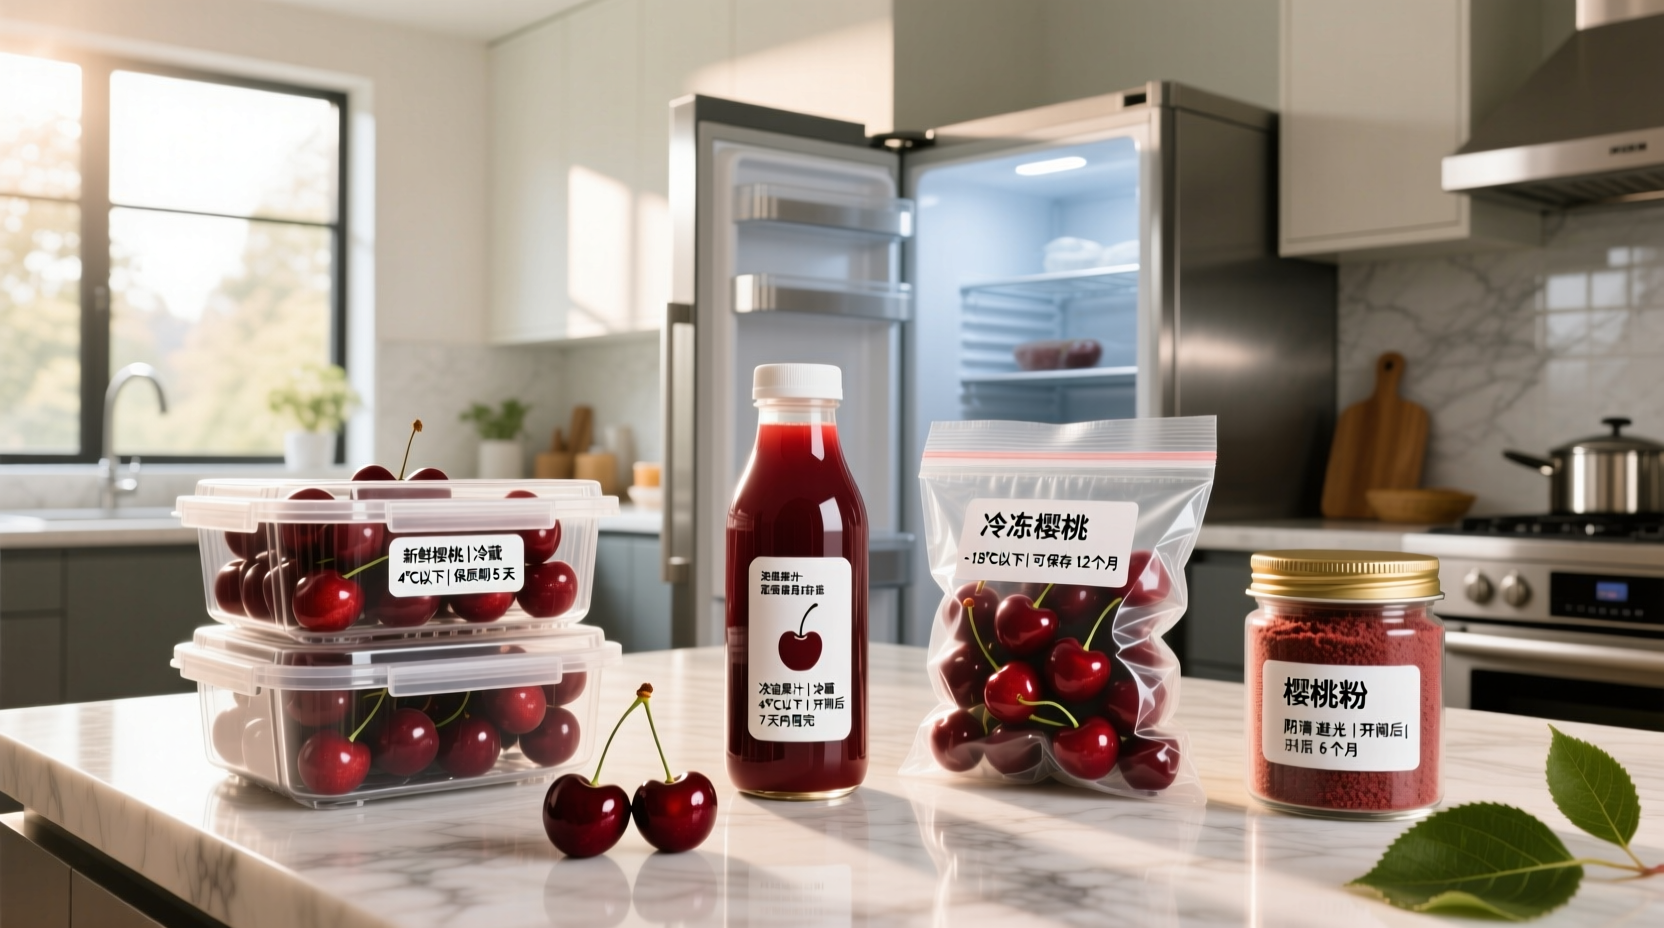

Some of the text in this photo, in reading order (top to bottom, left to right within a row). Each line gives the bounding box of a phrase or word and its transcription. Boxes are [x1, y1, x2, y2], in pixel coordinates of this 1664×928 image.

[980, 511, 1089, 541] 冷冻樱桃
[1283, 677, 1368, 710] 樱桃粉
